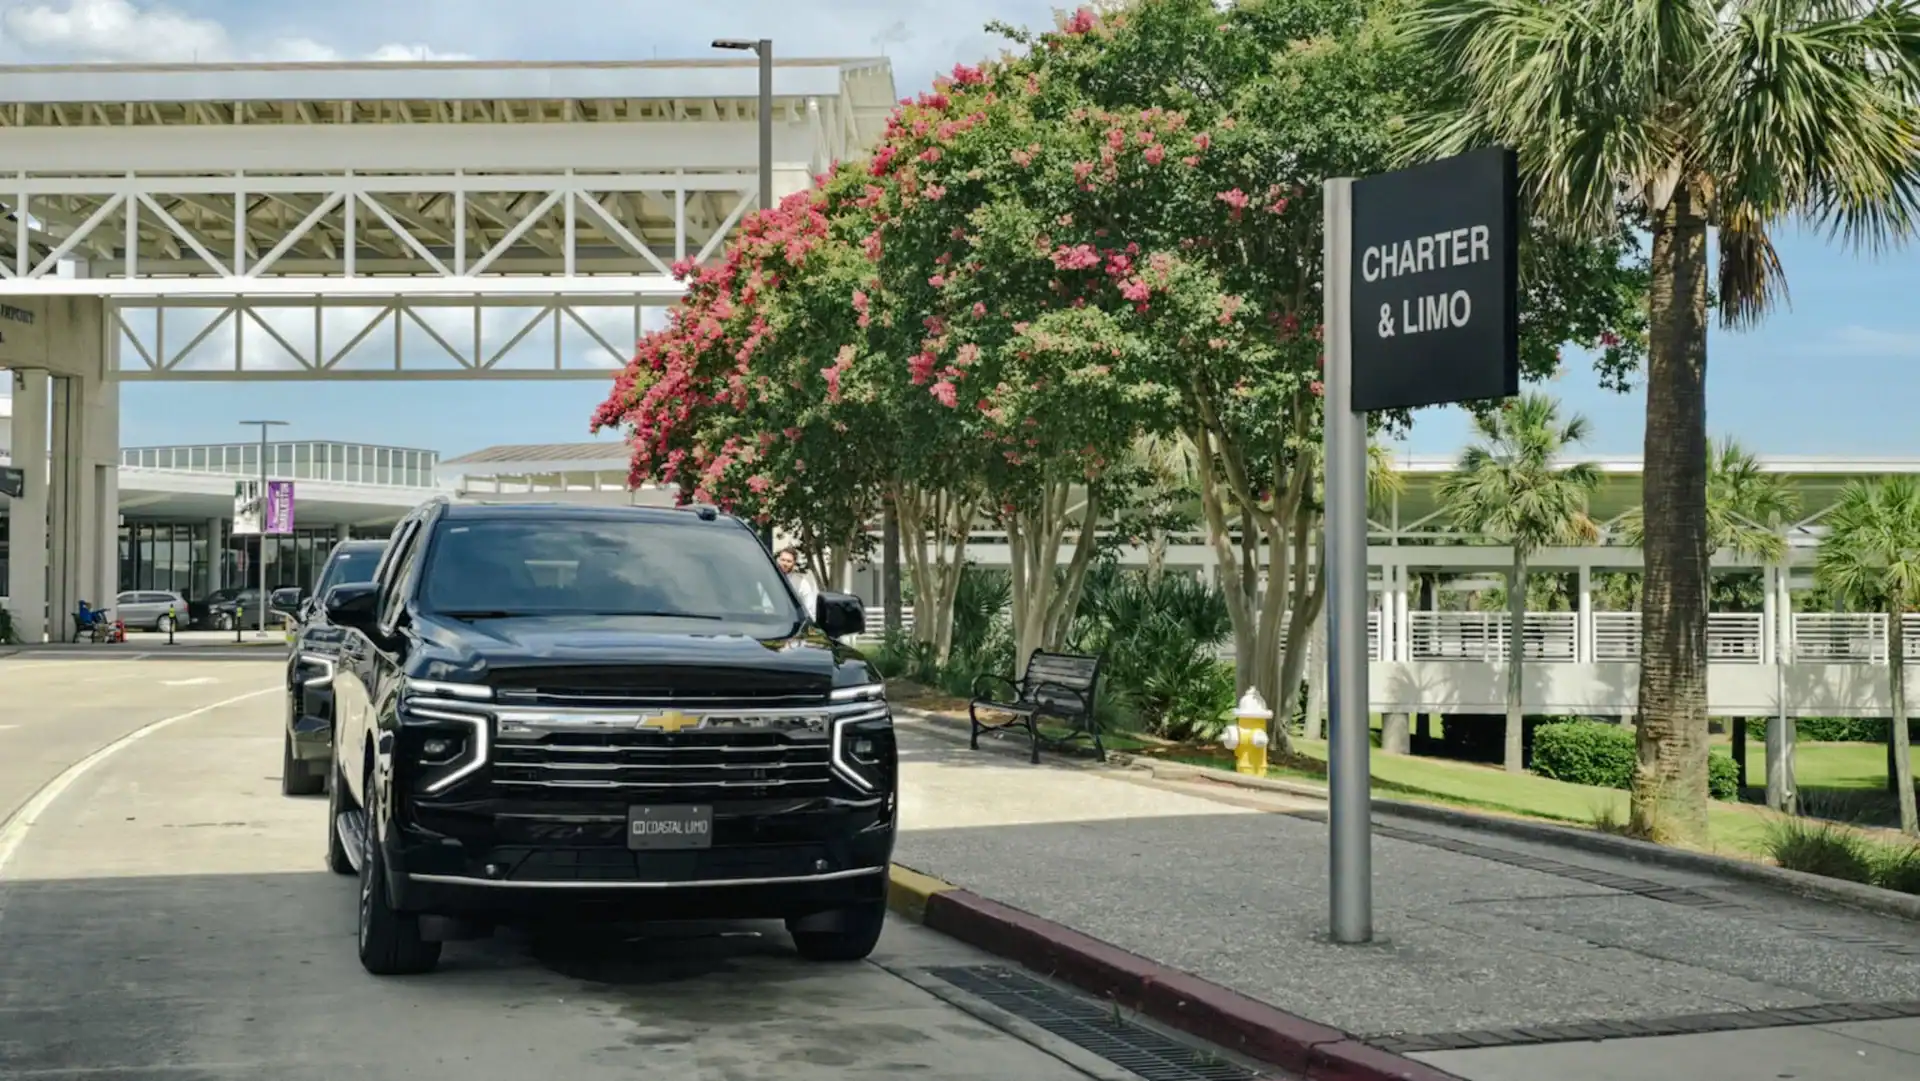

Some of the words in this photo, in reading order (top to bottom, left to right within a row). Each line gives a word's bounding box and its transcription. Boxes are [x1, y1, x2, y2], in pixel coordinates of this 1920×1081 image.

[1362, 225, 1490, 283] CHARTER
[0, 303, 34, 324] IRPORT
[1378, 302, 1396, 339] &
[1403, 290, 1472, 335] LIMO
[646, 820, 683, 834] COASTAL
[685, 820, 708, 834] LIMO
